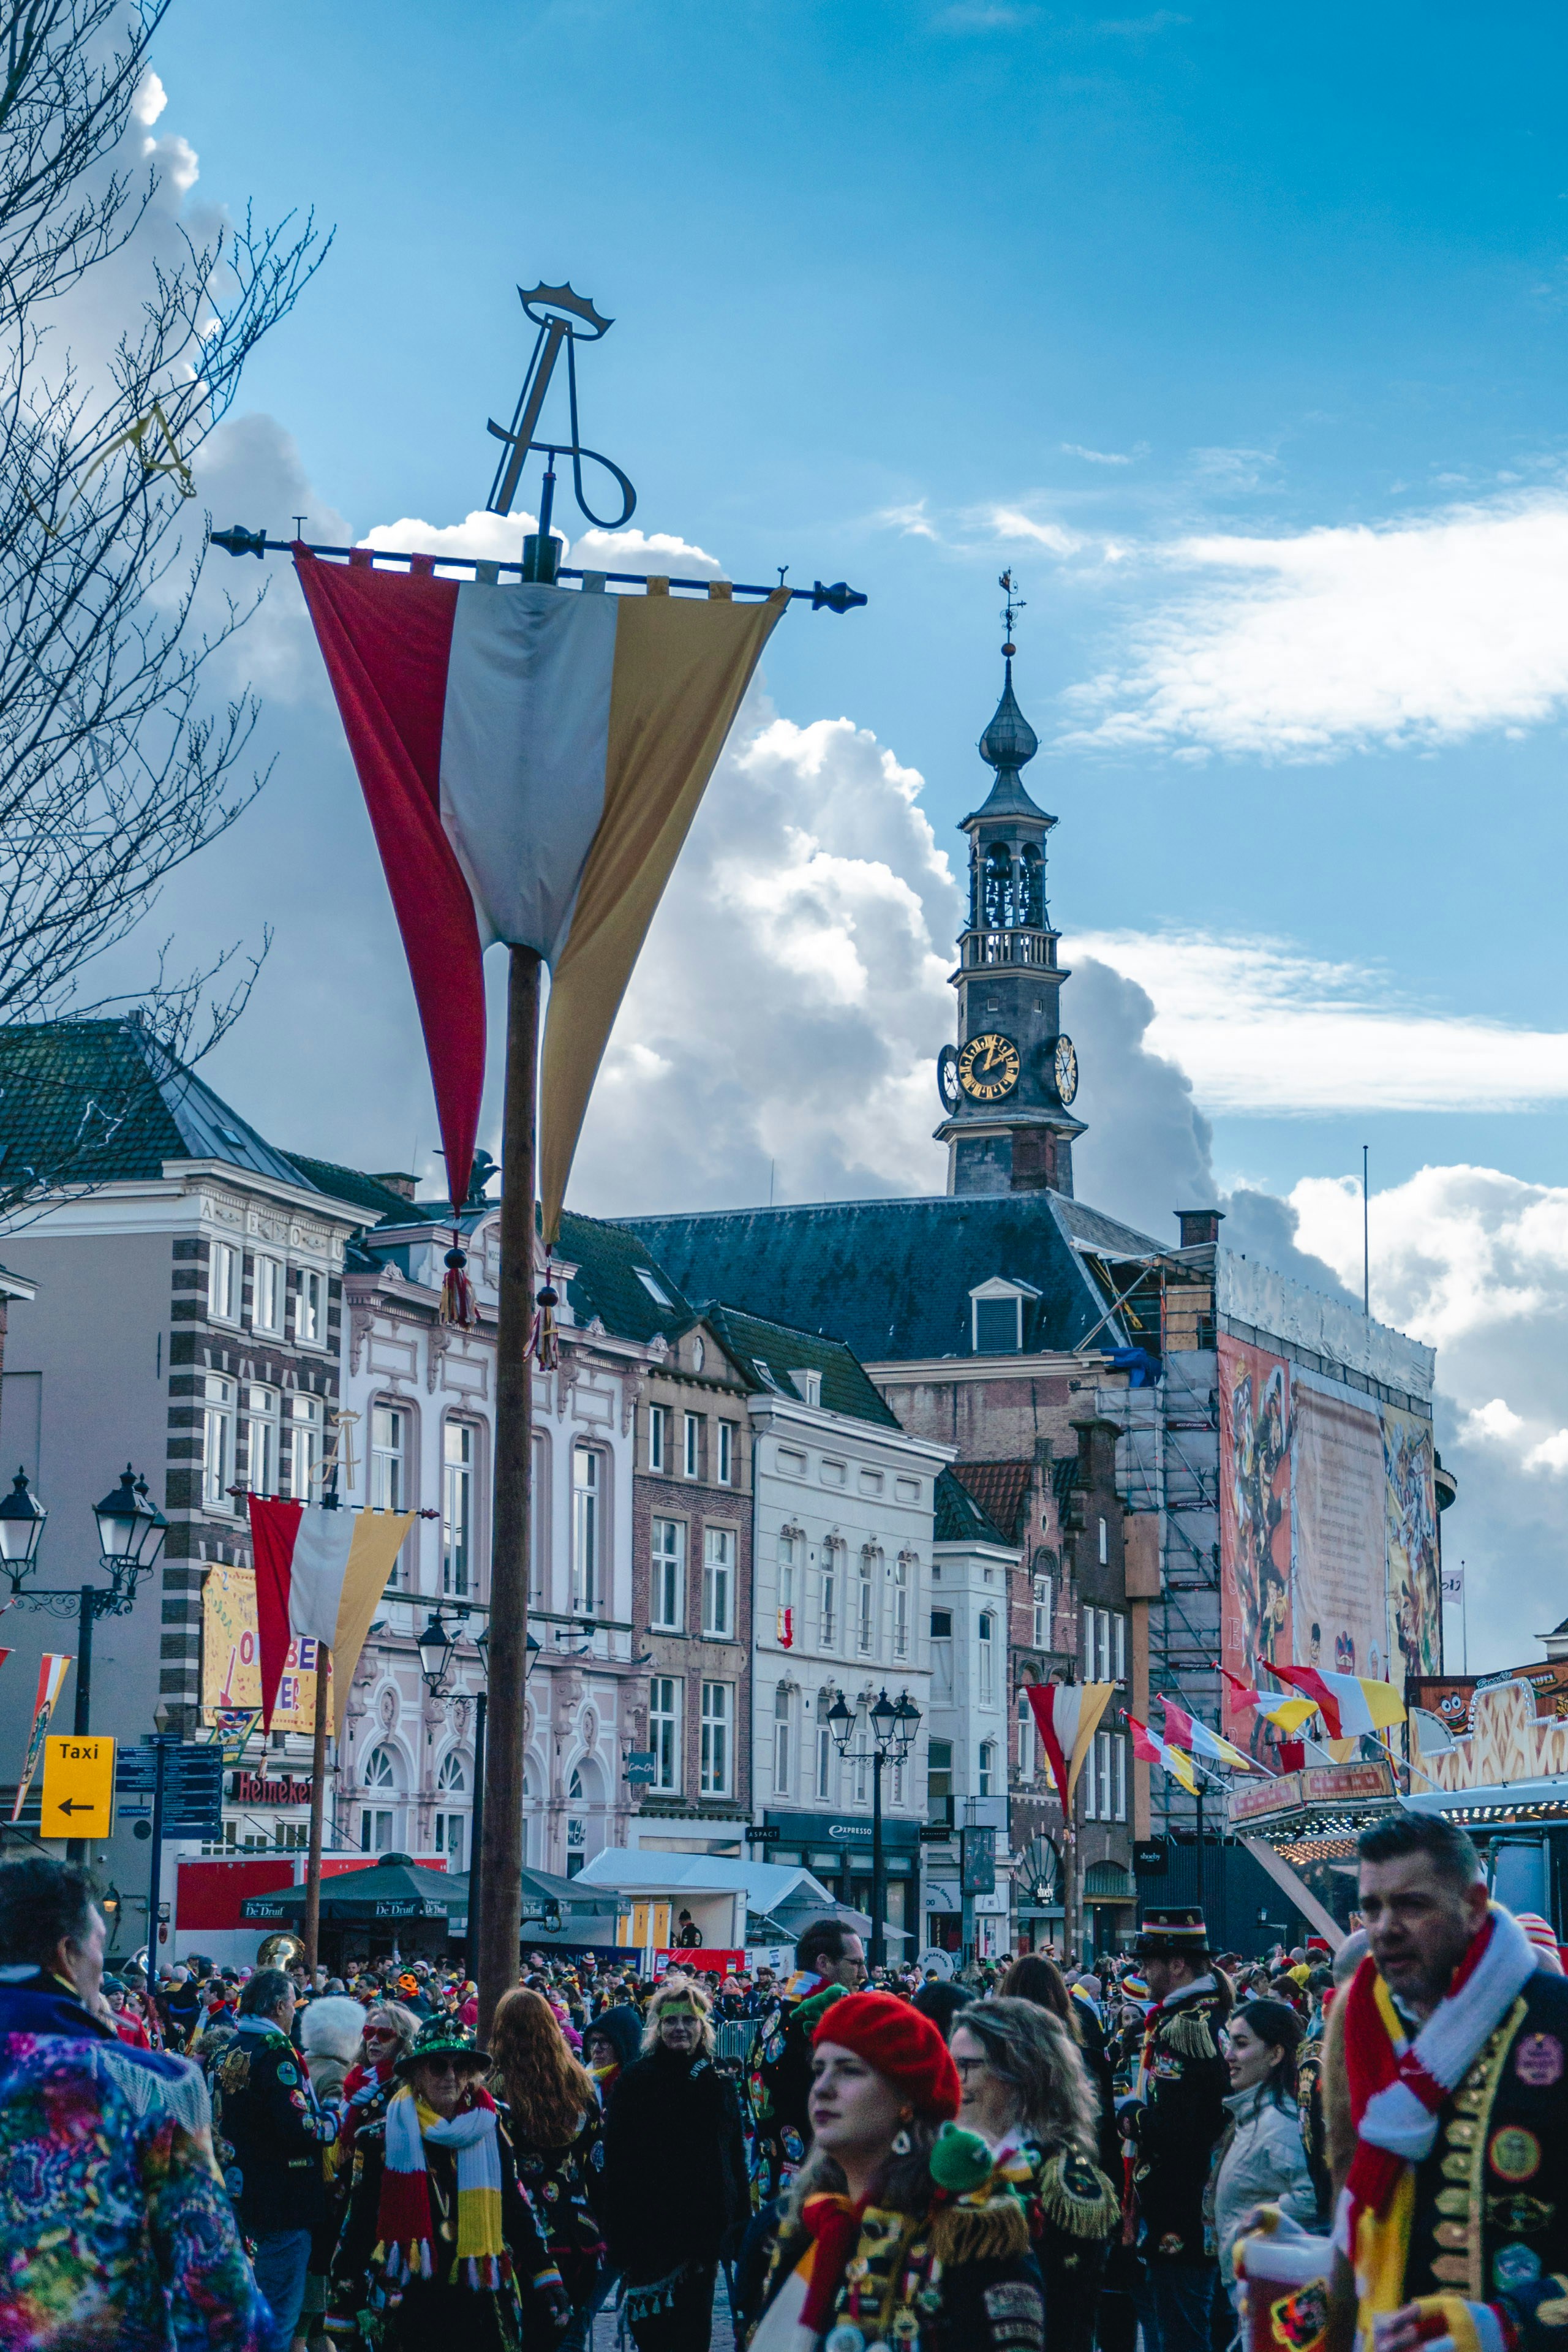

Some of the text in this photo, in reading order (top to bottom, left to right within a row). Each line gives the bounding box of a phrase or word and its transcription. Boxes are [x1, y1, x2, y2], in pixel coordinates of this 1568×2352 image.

[59, 1744, 99, 1760] Taxi
[1140, 1852, 1161, 1861] shoeby
[940, 1888, 954, 1909] Service
[1037, 1883, 1054, 1901] shoeby
[246, 1906, 285, 1916] De Druif
[375, 1904, 415, 1915] De Druif
